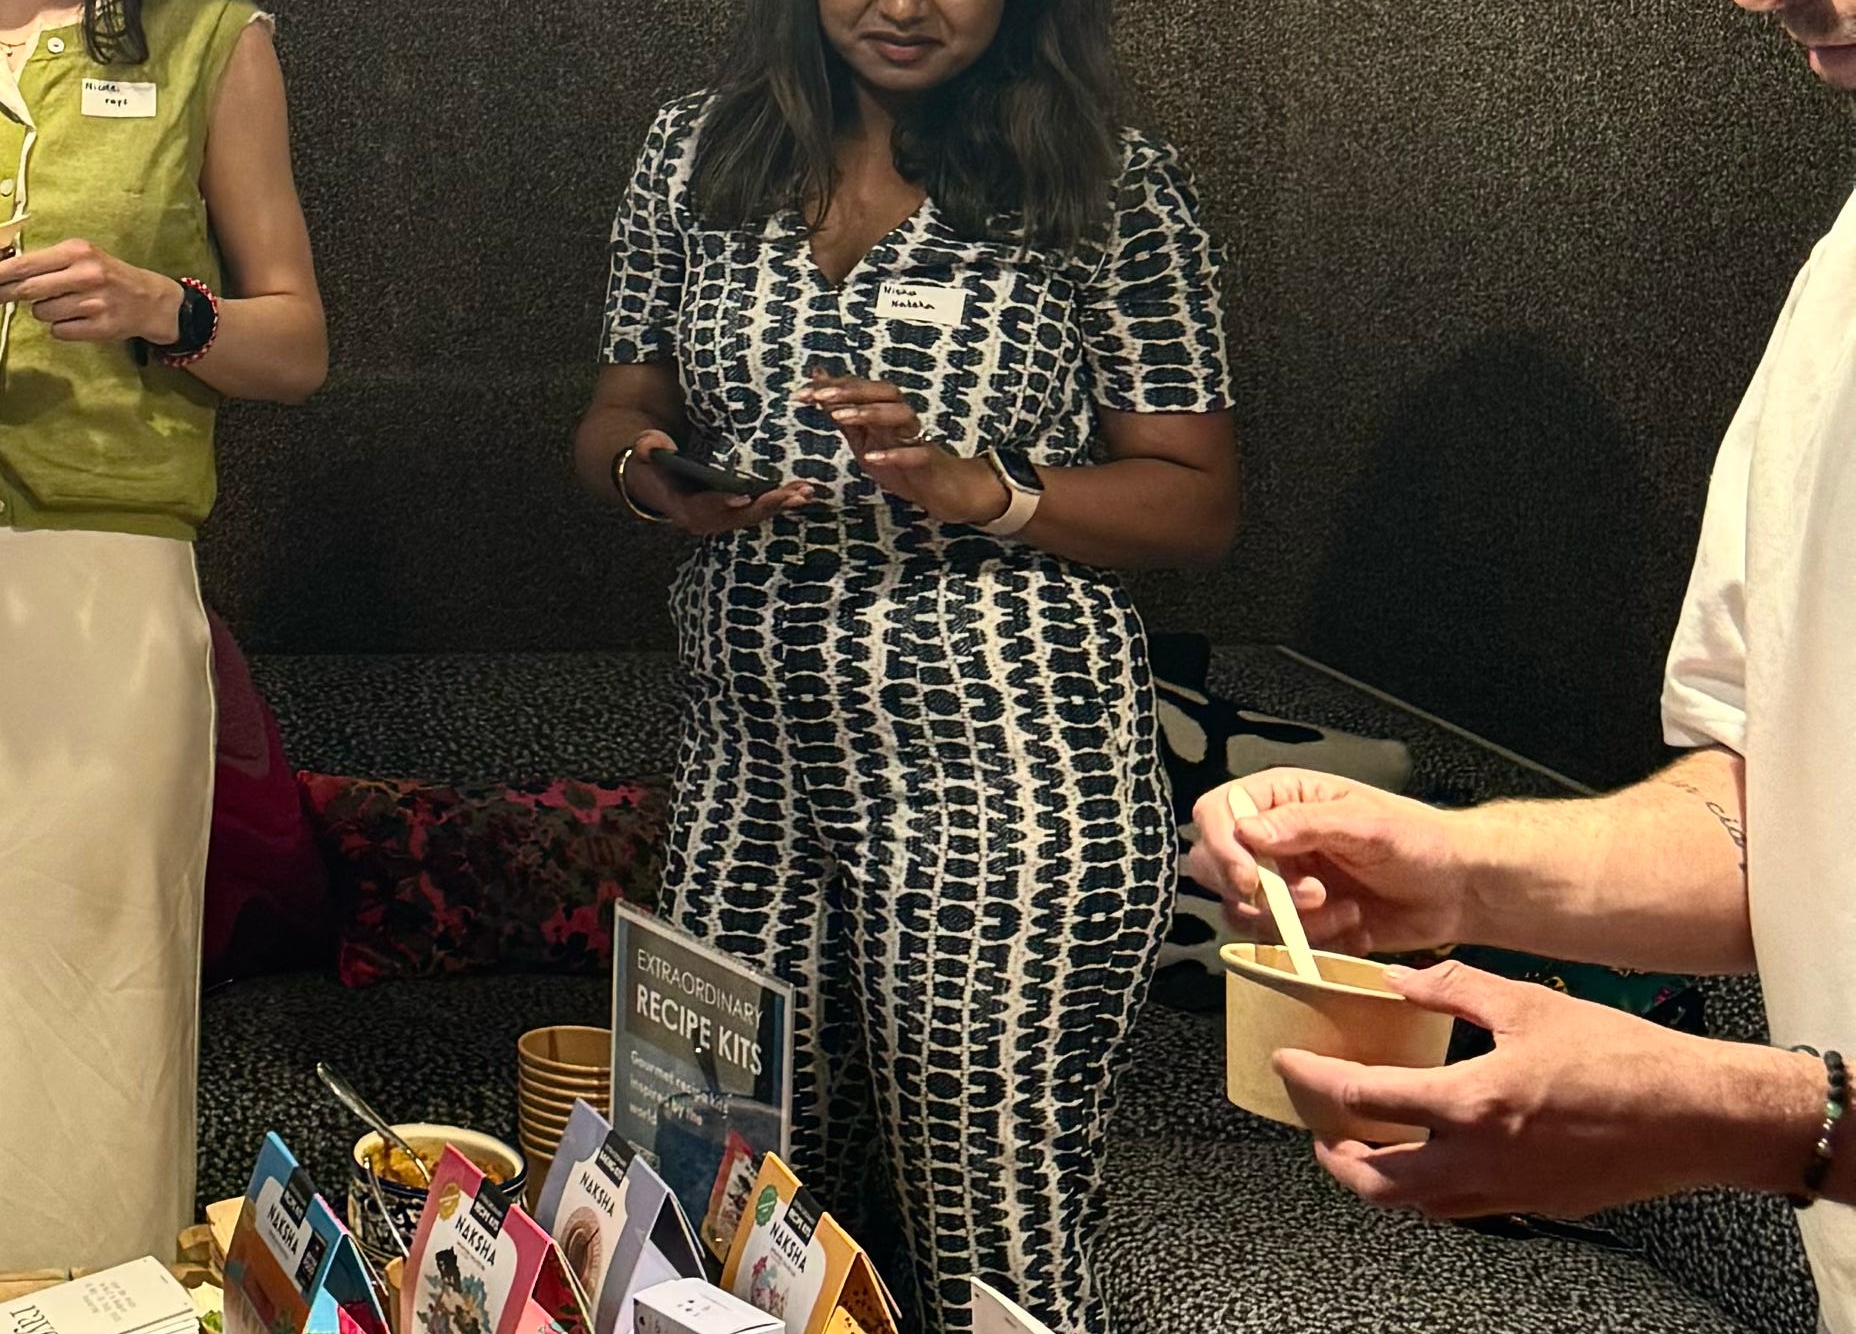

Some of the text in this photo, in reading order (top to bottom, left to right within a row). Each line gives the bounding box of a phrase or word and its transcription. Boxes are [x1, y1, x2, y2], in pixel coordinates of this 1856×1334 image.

[638, 948, 763, 1031] EXTRAORDINARY
[636, 984, 763, 1076] RECIPE KITS
[580, 1172, 615, 1217] NAKSHA
[267, 1203, 299, 1255] NAKSHA
[455, 1215, 496, 1266] NAKSHA
[769, 1221, 807, 1273] NAKSHA
